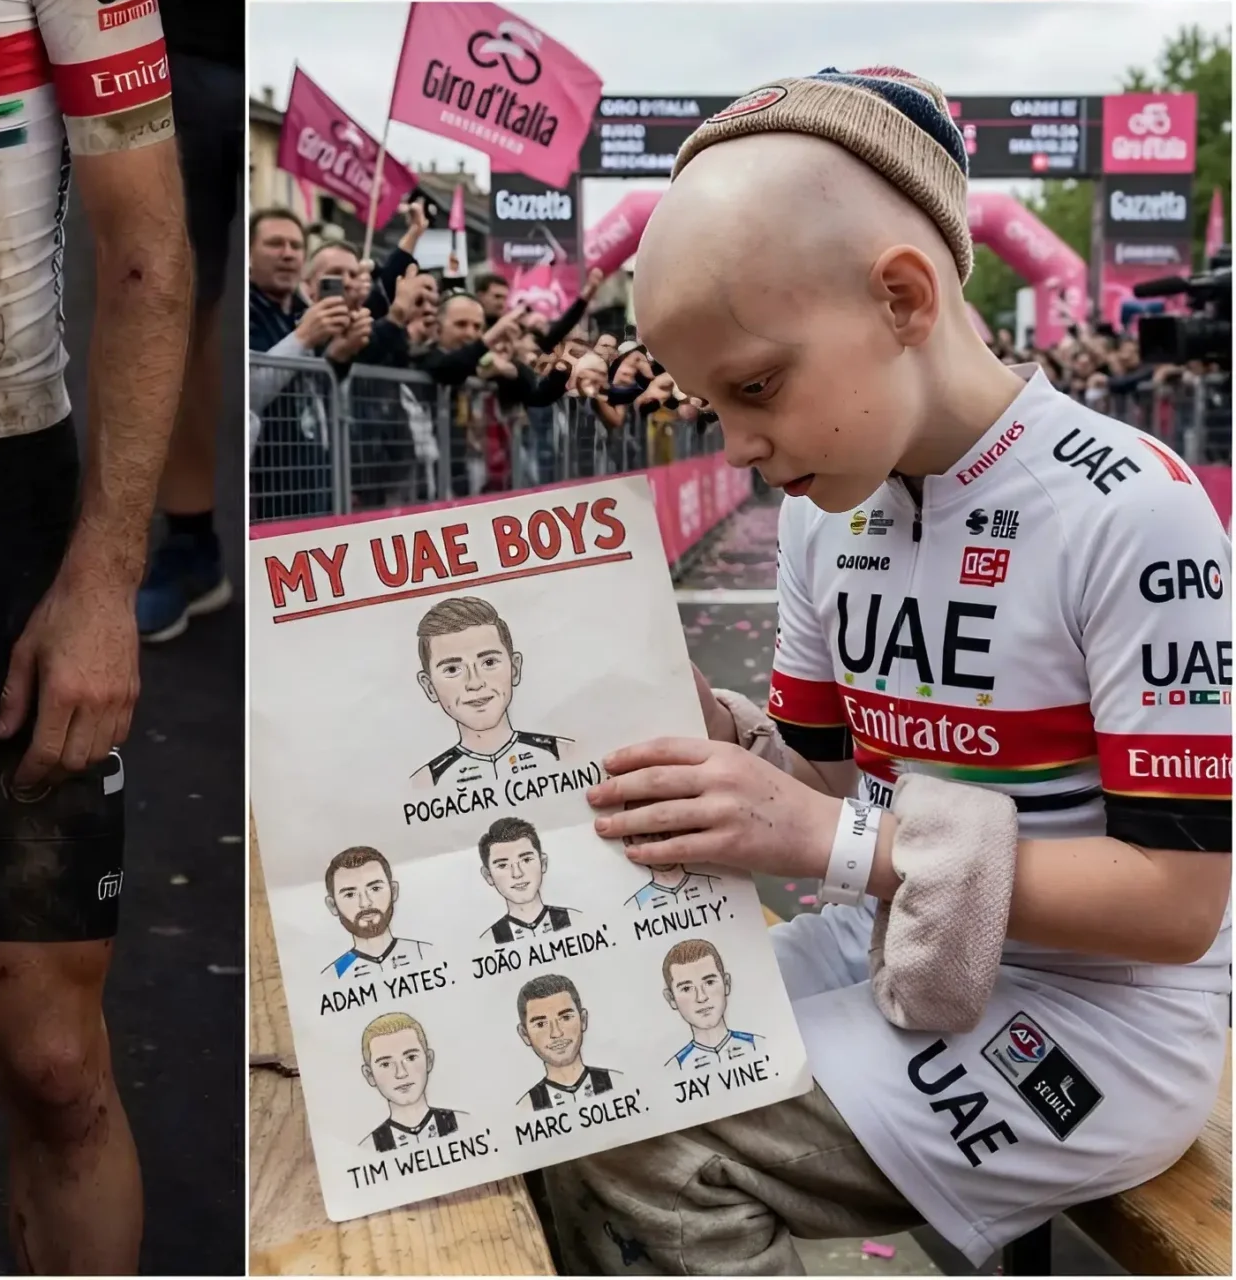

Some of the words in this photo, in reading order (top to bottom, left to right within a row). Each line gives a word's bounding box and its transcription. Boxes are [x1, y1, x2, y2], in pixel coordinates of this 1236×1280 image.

[422, 59, 475, 111] Giro
[475, 83, 558, 148] d'Italia
[956, 420, 1026, 487] Emirates
[1052, 428, 1142, 495] UAE
[265, 543, 348, 608] MY
[370, 523, 478, 588] UAE
[492, 497, 627, 569] BOYS
[837, 591, 997, 690] UAE
[843, 694, 1000, 757] Emirates
[404, 786, 499, 825] POGAČAR
[472, 947, 522, 979] JOÃO
[319, 983, 379, 1016] ADAM
[675, 1076, 712, 1105] JAY
[908, 1037, 1018, 1168] UAE
[515, 1113, 572, 1146] MARC
[347, 1161, 389, 1190] TIM
